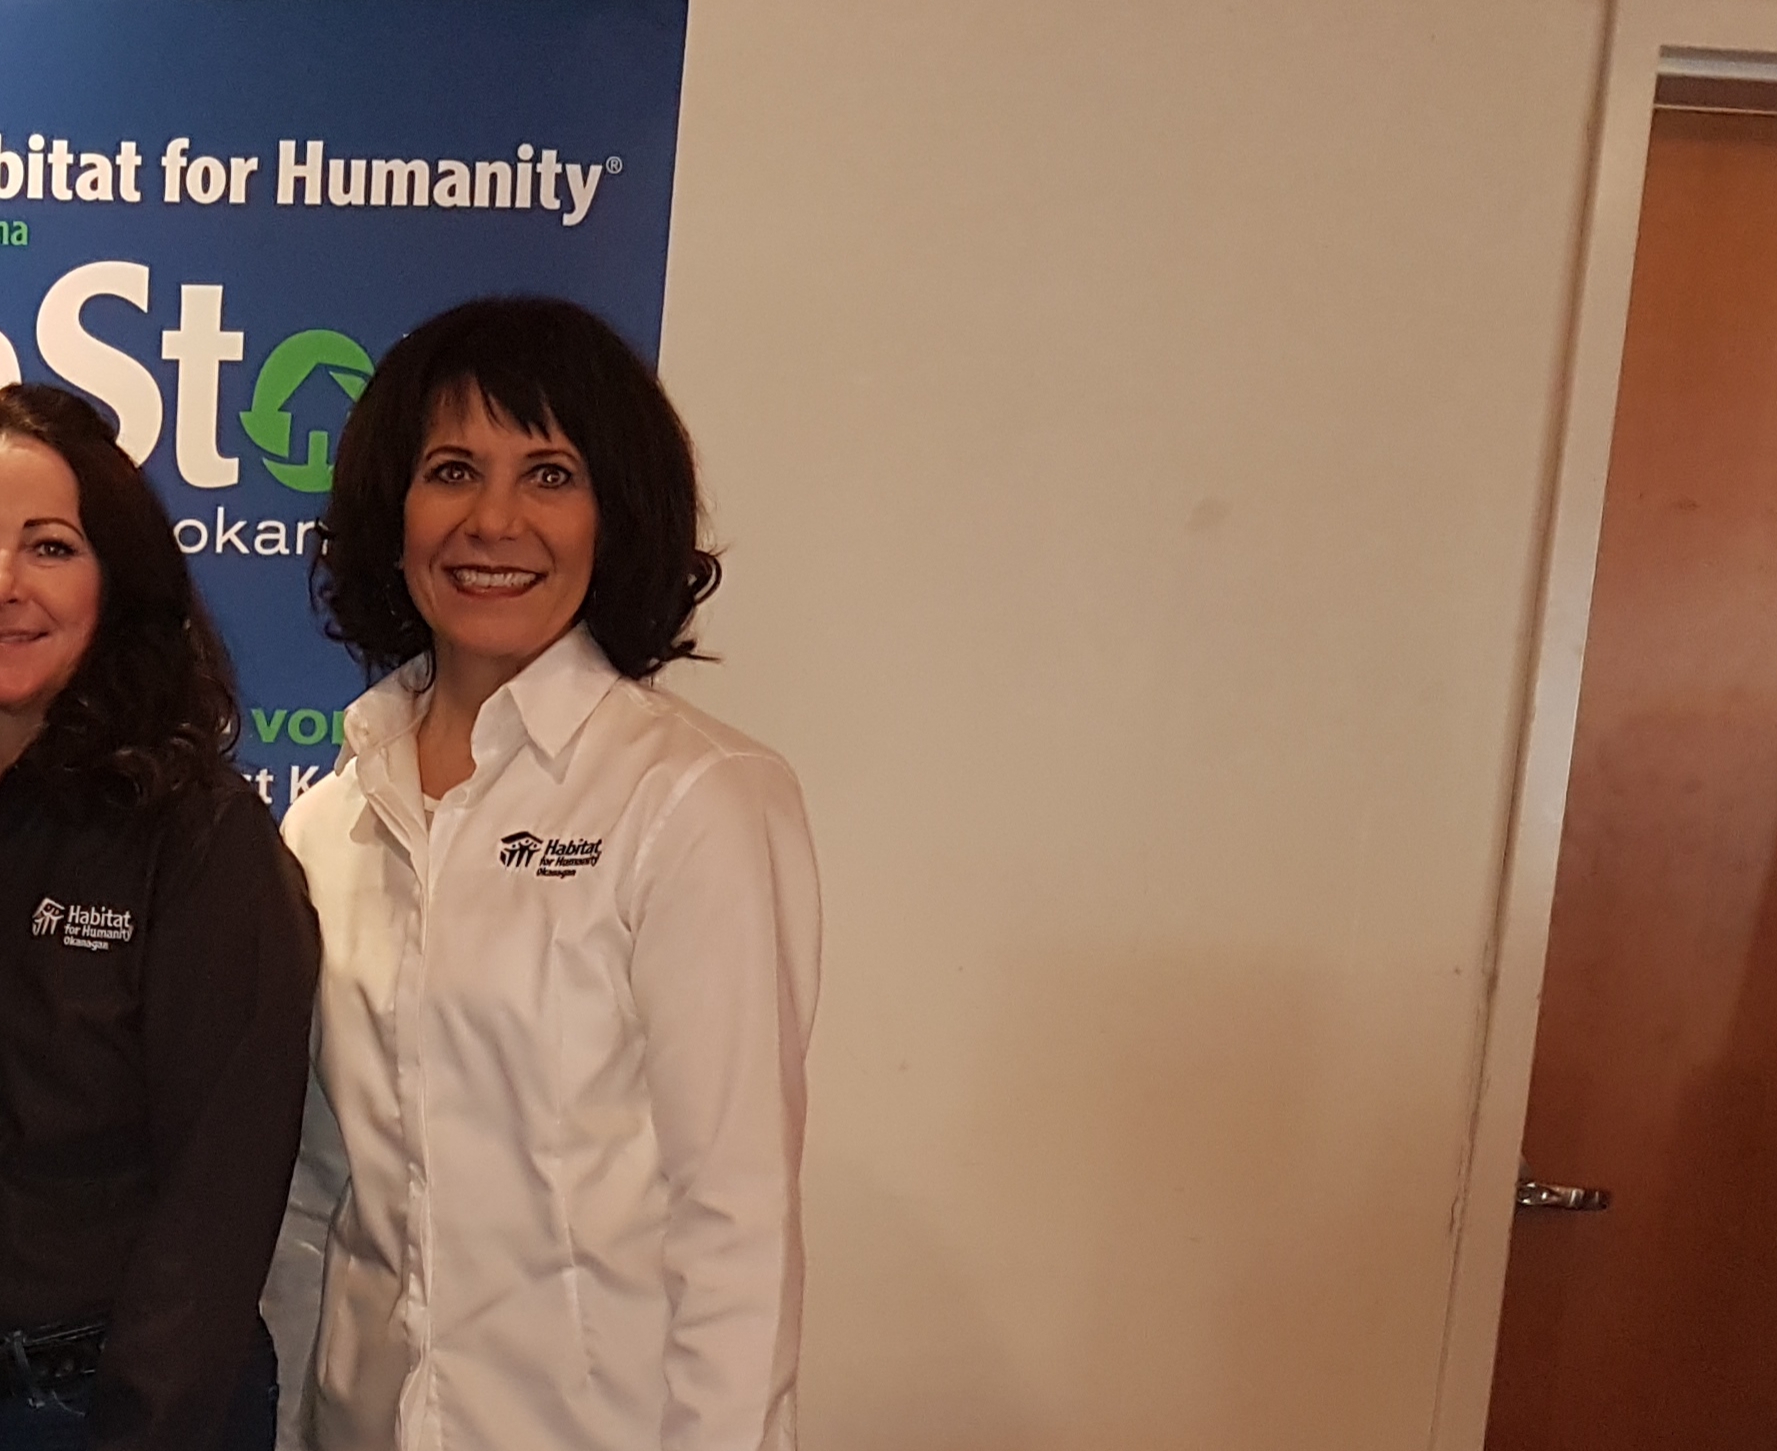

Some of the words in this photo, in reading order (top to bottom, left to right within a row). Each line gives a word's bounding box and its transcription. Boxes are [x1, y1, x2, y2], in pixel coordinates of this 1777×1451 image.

[161, 137, 258, 205] for
[545, 838, 602, 856] Habitat
[67, 905, 131, 928] Habitat
[64, 923, 81, 935] for
[82, 924, 134, 942] Humanity
[63, 936, 109, 951] Okanagan
